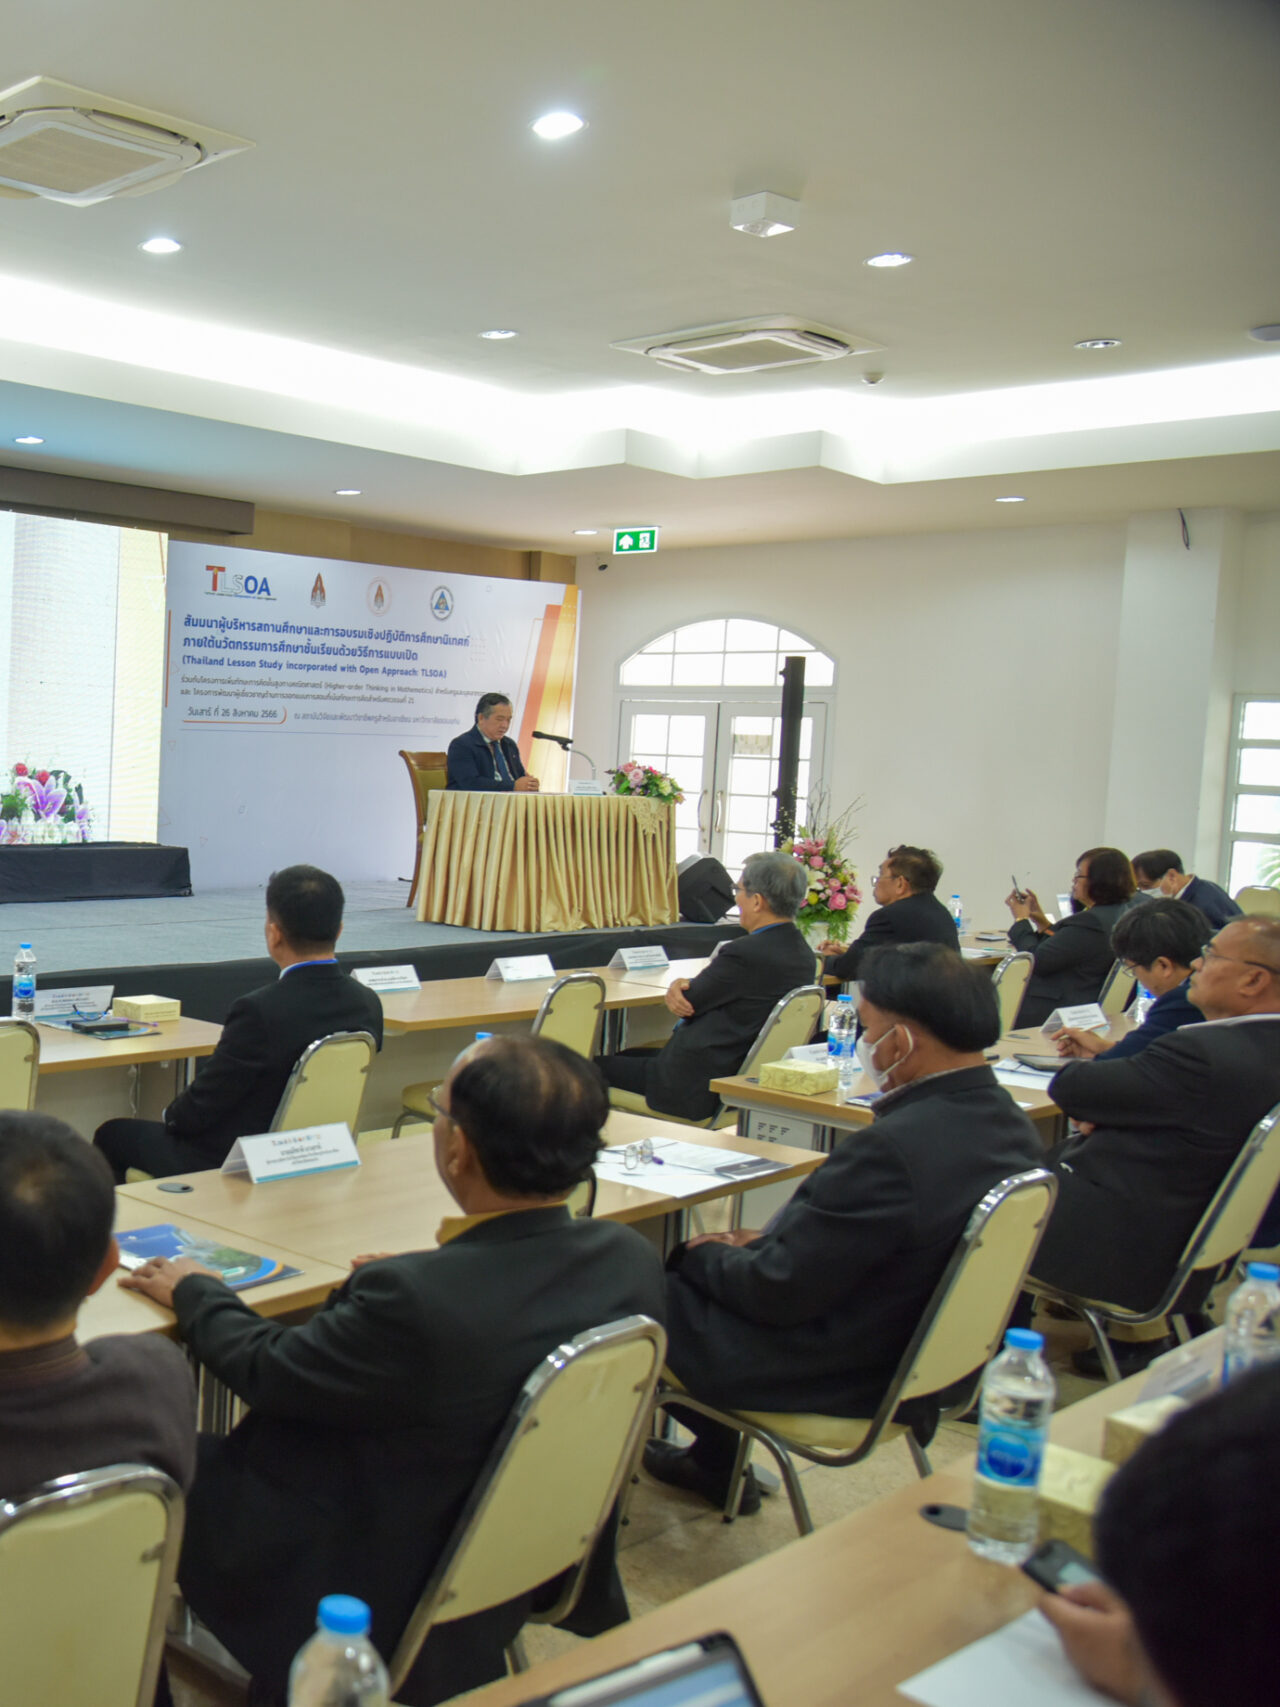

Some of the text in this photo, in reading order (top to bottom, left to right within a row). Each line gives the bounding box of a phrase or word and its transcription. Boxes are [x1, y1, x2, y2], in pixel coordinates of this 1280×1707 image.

[205, 565, 271, 596] TLSOA
[182, 655, 447, 679] (Thailand Lesson Study incorporated with Open Approach: TLSOA)
[221, 708, 230, 717] 26
